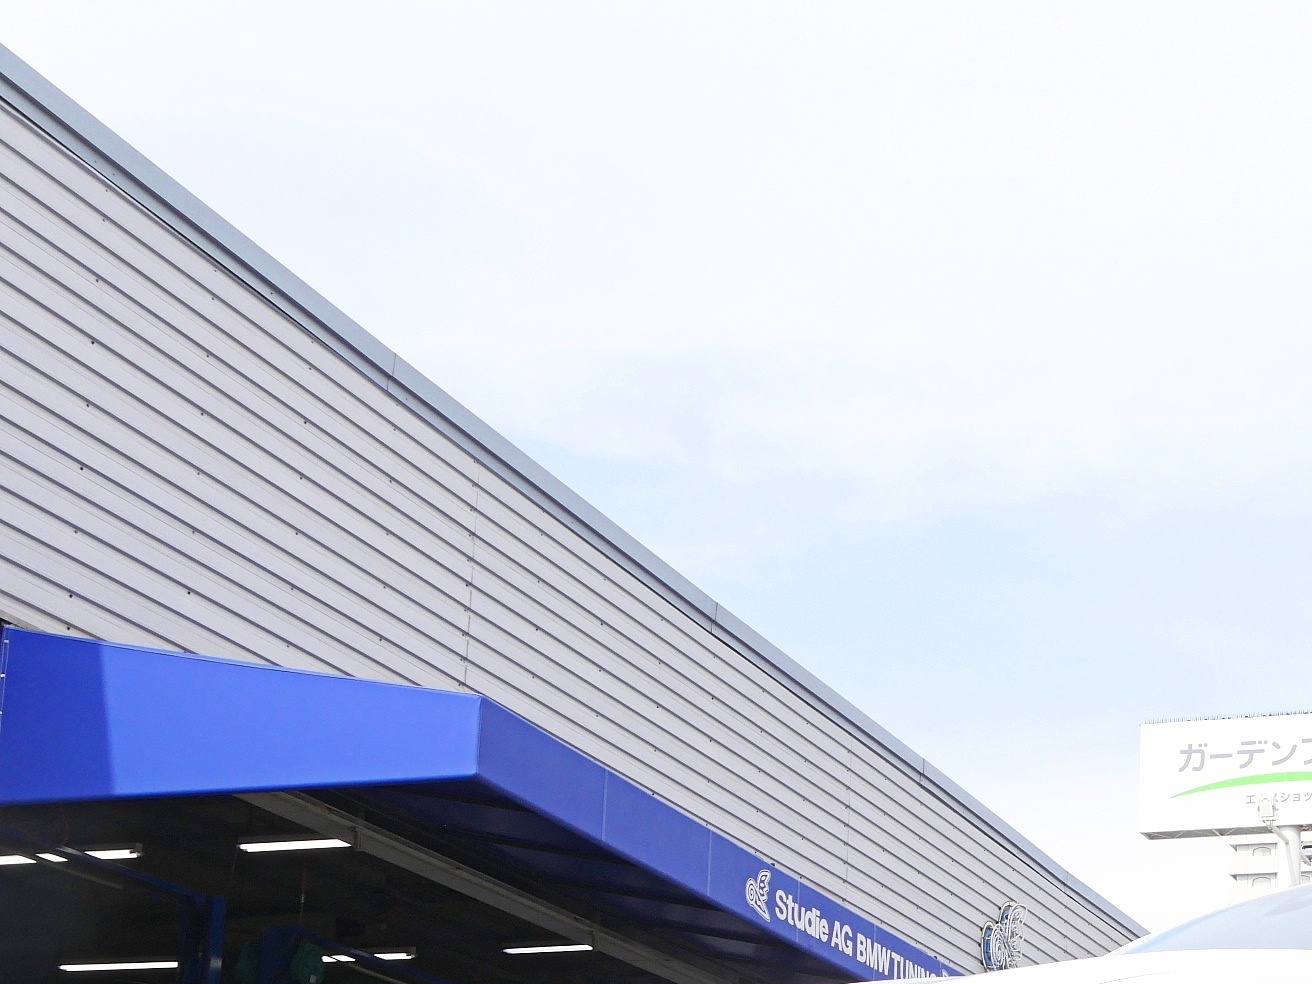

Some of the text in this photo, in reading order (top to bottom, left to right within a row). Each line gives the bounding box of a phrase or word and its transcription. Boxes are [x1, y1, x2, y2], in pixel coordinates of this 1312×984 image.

[775, 889, 829, 942] Studie
[831, 920, 853, 957] AG
[856, 932, 891, 976] BMW
